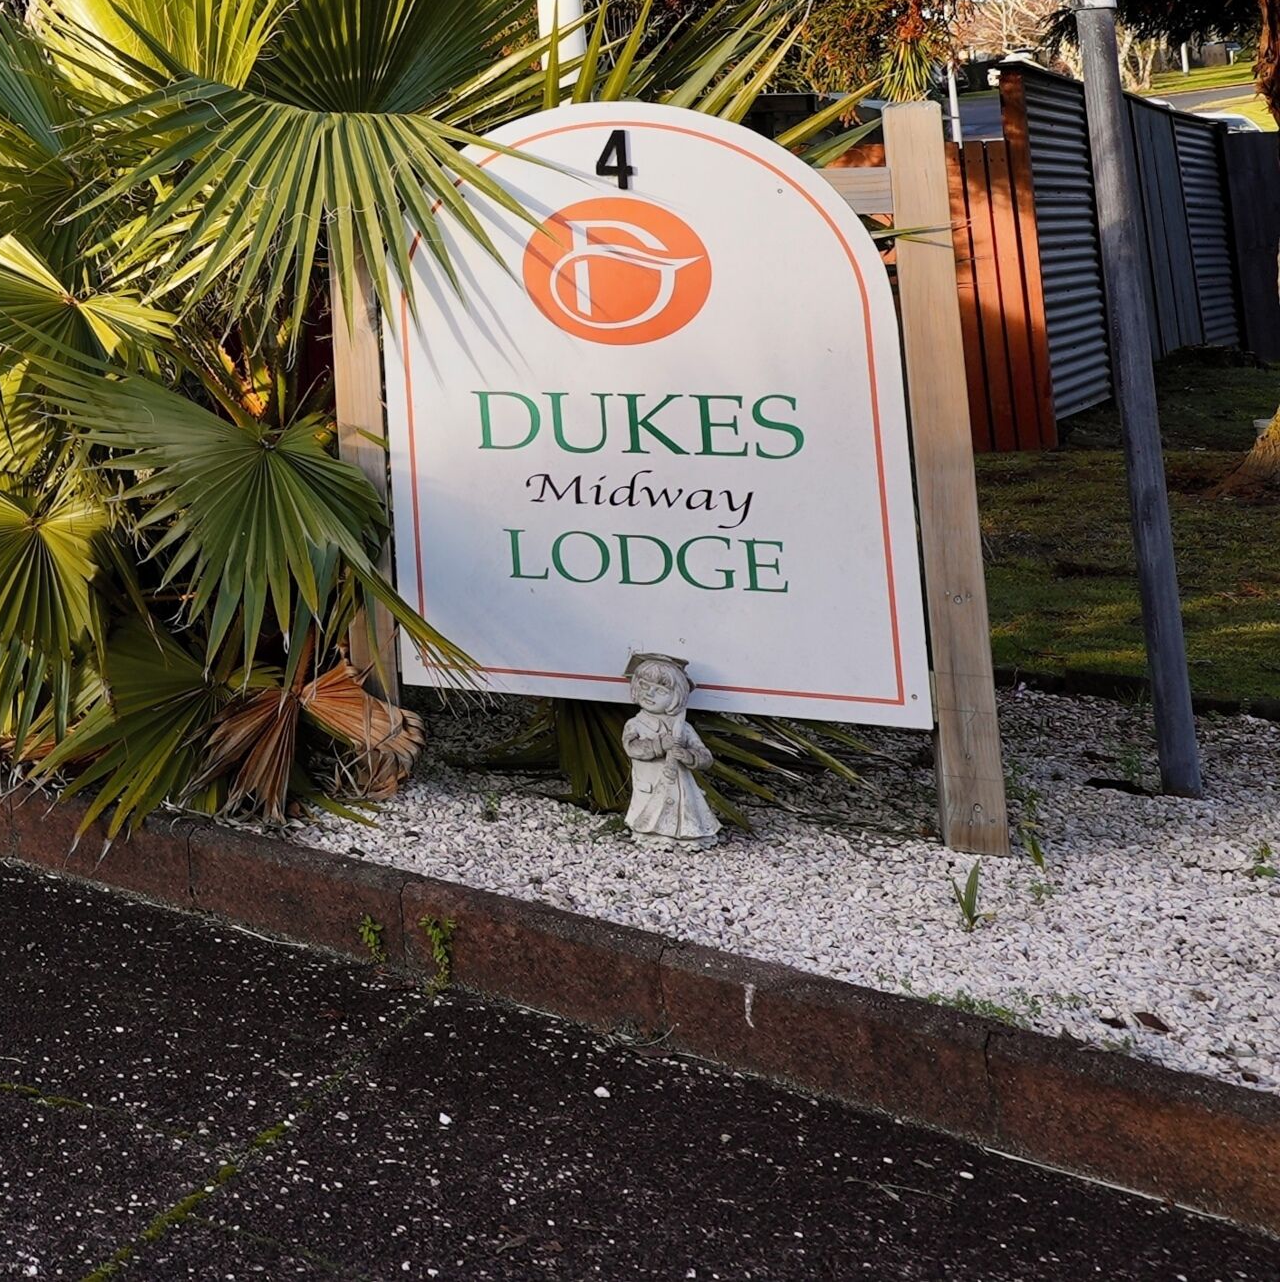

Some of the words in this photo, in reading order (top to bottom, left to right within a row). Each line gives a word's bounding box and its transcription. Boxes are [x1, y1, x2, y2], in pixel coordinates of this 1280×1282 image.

[596, 130, 633, 190] 4
[471, 391, 805, 459] DUKES
[526, 470, 753, 529] Midway
[503, 529, 789, 593] LODGE
